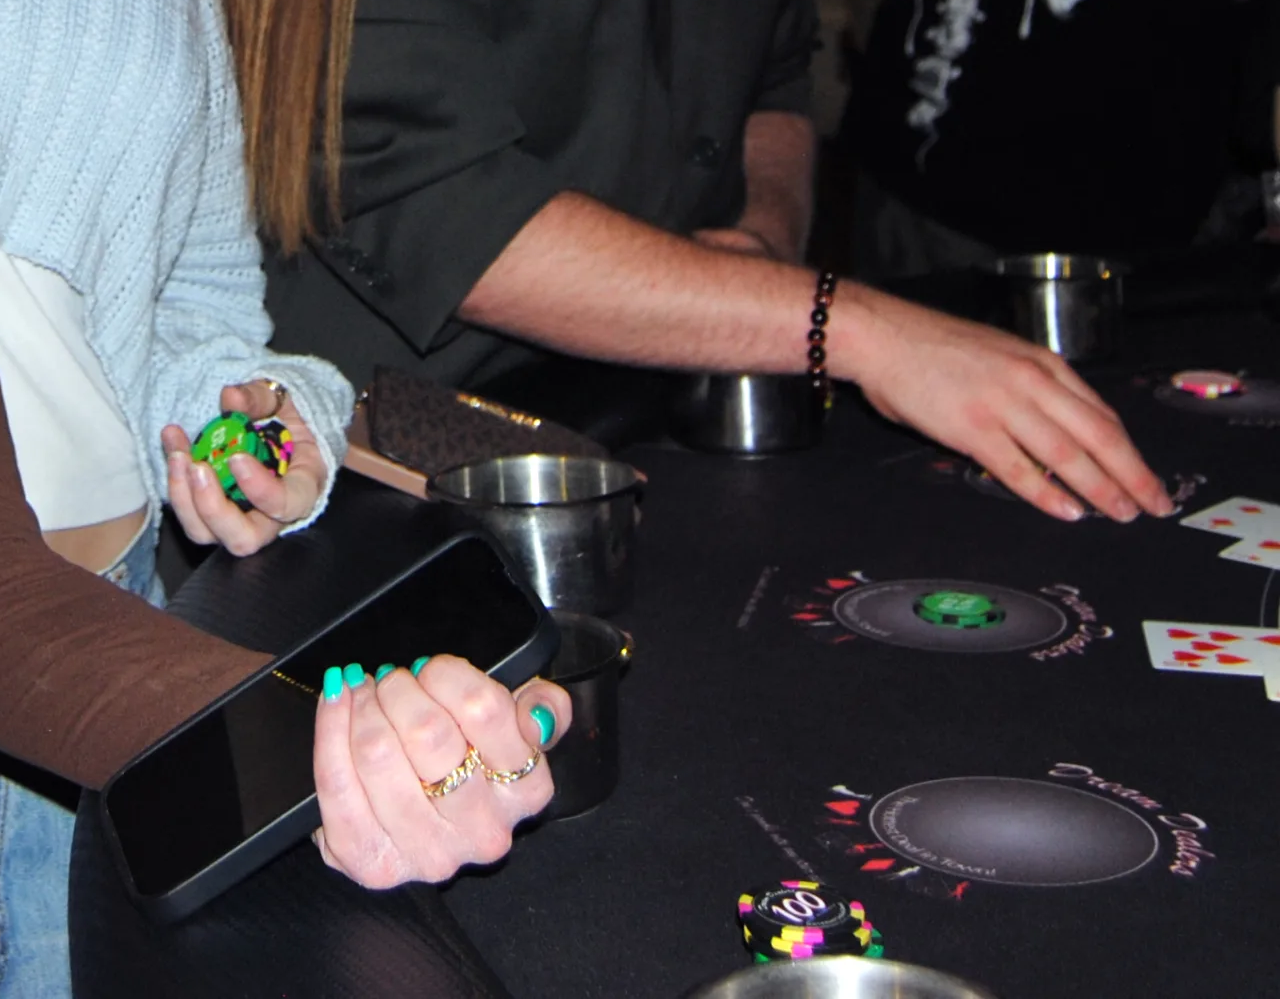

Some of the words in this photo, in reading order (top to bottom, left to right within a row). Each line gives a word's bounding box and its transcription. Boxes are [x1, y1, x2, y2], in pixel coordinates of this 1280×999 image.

[1048, 762, 1163, 809] Dream
[1157, 813, 1216, 877] Dealers
[772, 890, 826, 923] 100
